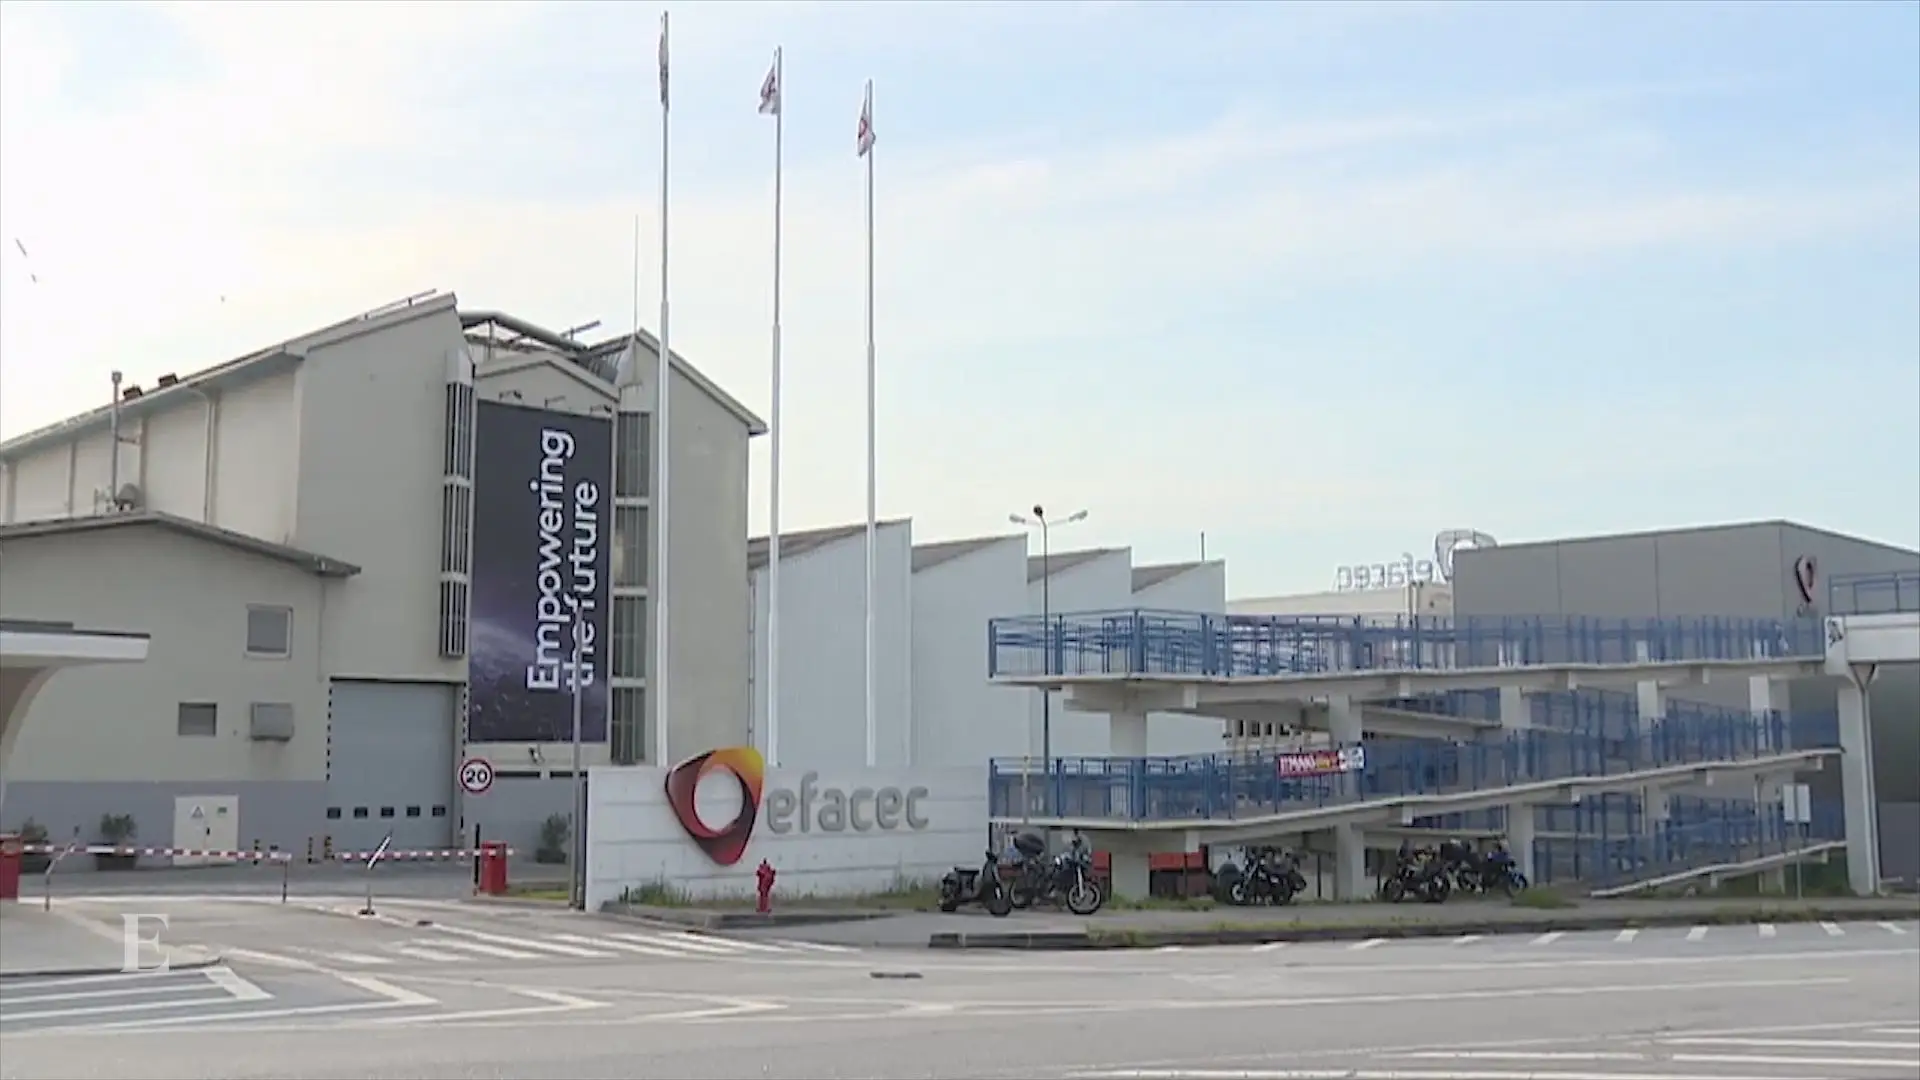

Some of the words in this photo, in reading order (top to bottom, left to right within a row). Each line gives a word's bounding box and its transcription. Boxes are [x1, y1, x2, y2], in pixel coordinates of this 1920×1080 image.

[527, 428, 576, 691] Empowering
[564, 481, 599, 611] future
[563, 621, 595, 694] the
[466, 769, 488, 784] 20
[766, 772, 930, 834] efacec
